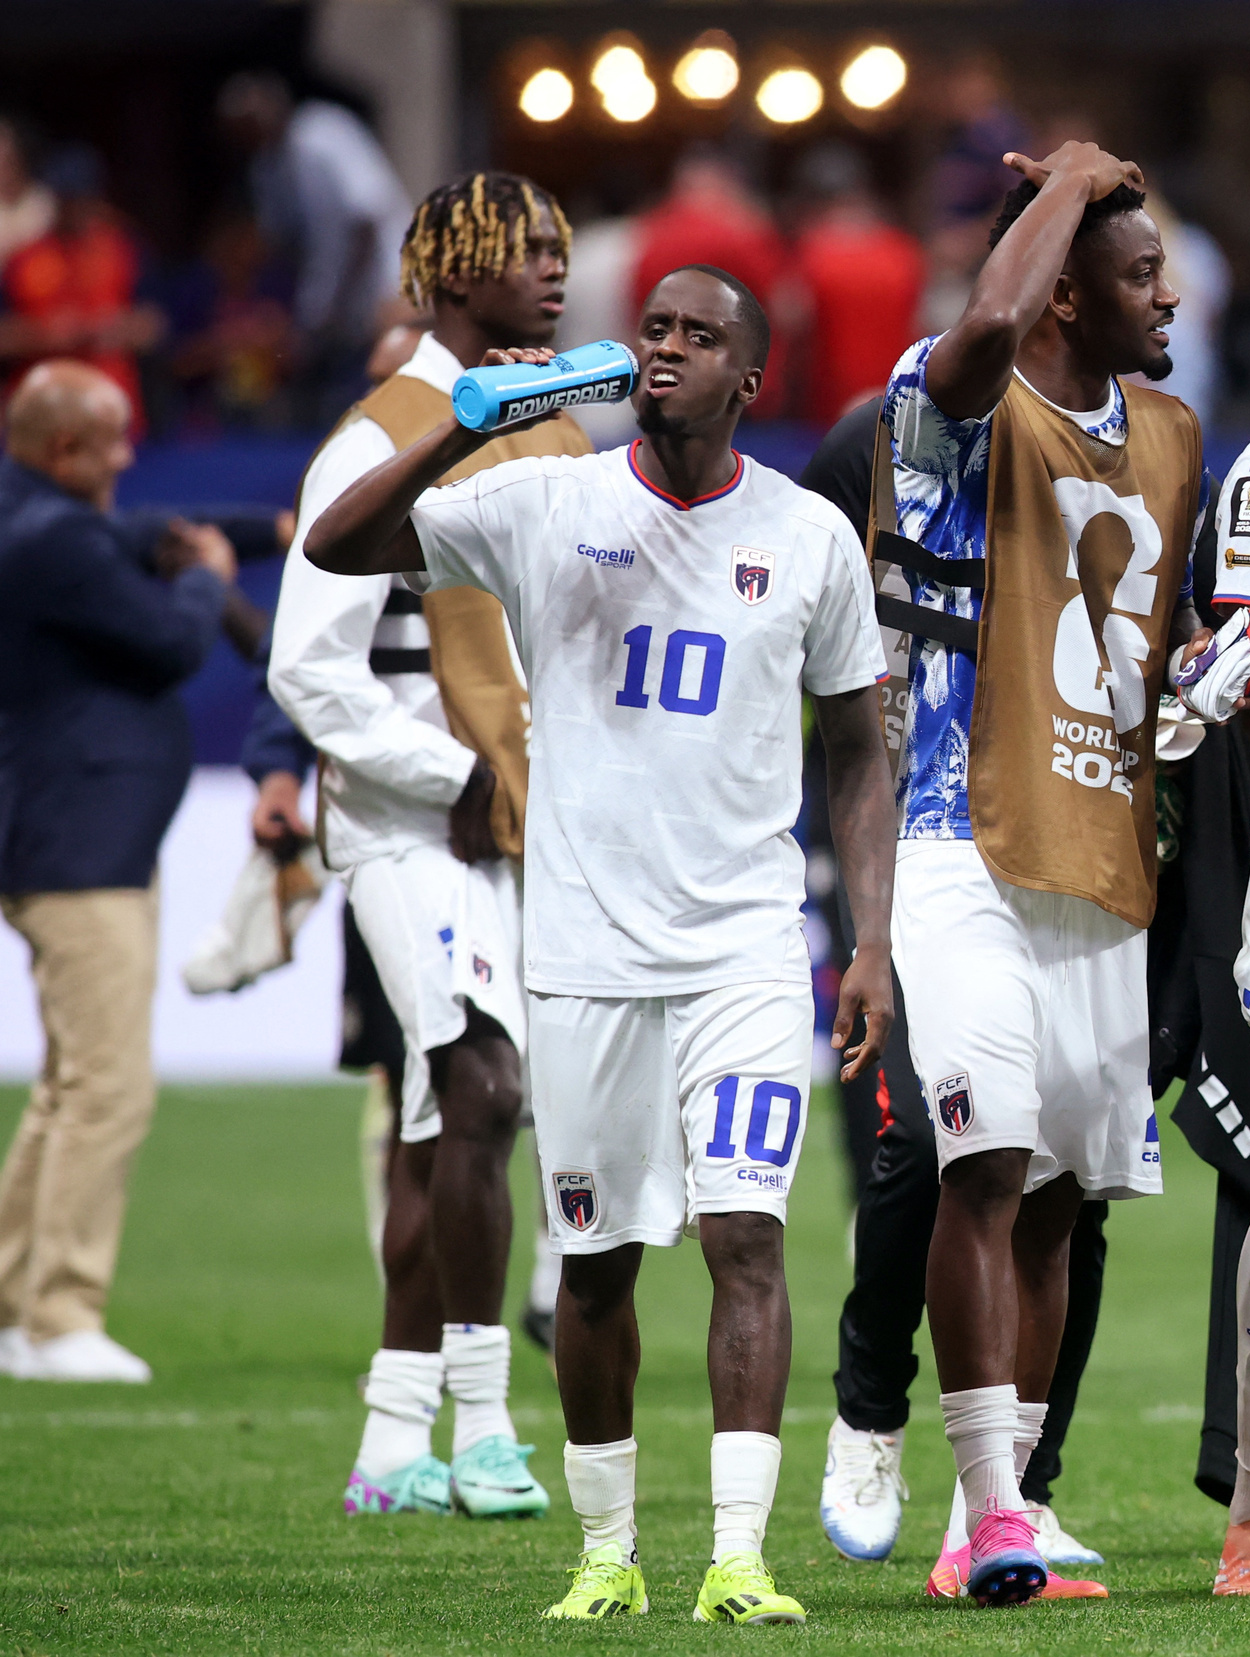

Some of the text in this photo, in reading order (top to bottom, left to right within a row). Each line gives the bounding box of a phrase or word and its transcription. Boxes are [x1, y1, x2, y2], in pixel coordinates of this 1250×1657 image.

[506, 380, 622, 422] POWERADE
[577, 543, 636, 564] capelli
[736, 549, 772, 562] FCF
[600, 560, 633, 571] SPORT
[615, 624, 727, 717] 10
[936, 1076, 966, 1095] FCF
[706, 1075, 802, 1168] 10
[556, 1175, 590, 1186] FCF
